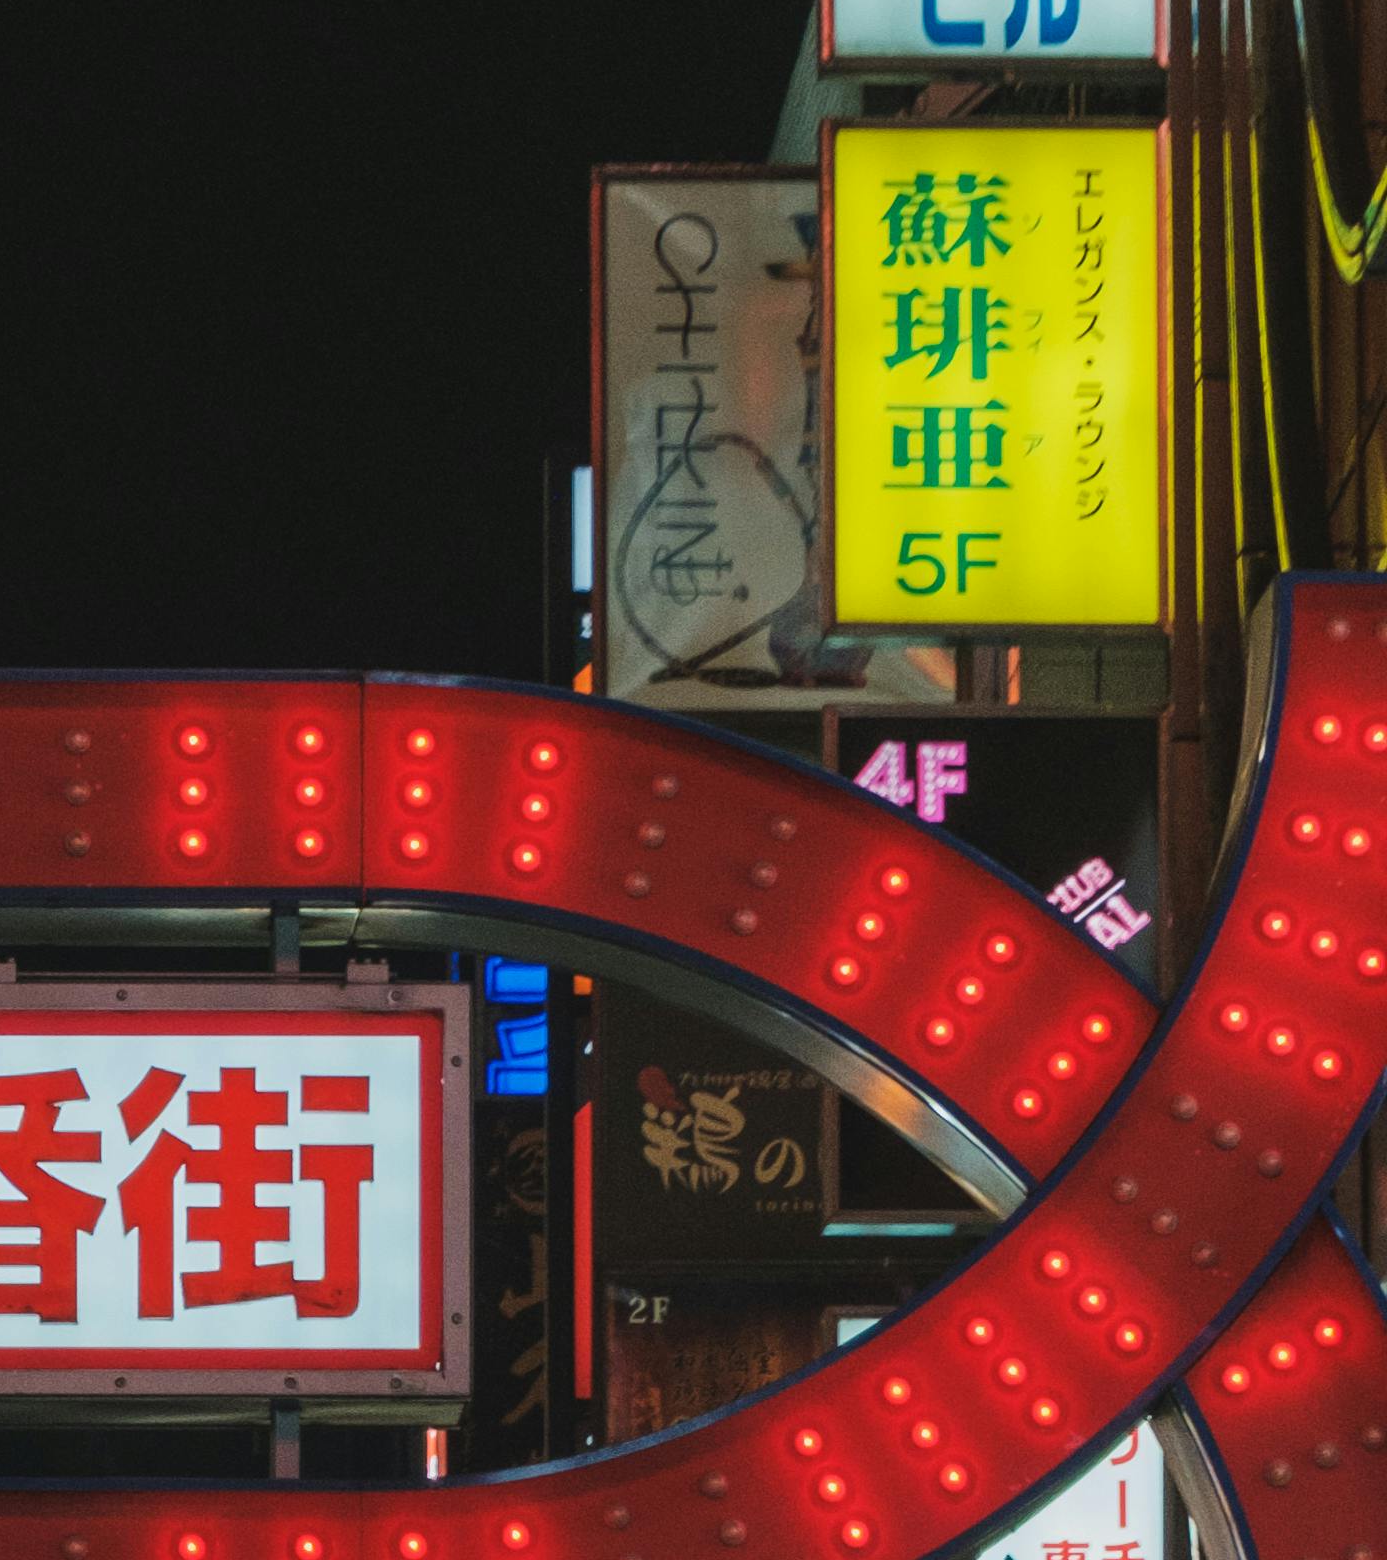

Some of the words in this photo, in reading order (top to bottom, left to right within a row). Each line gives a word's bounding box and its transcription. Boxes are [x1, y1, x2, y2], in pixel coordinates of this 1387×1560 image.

[895, 531, 1003, 597] 5F
[853, 741, 968, 823] 4F
[628, 1294, 671, 1326] 2F
